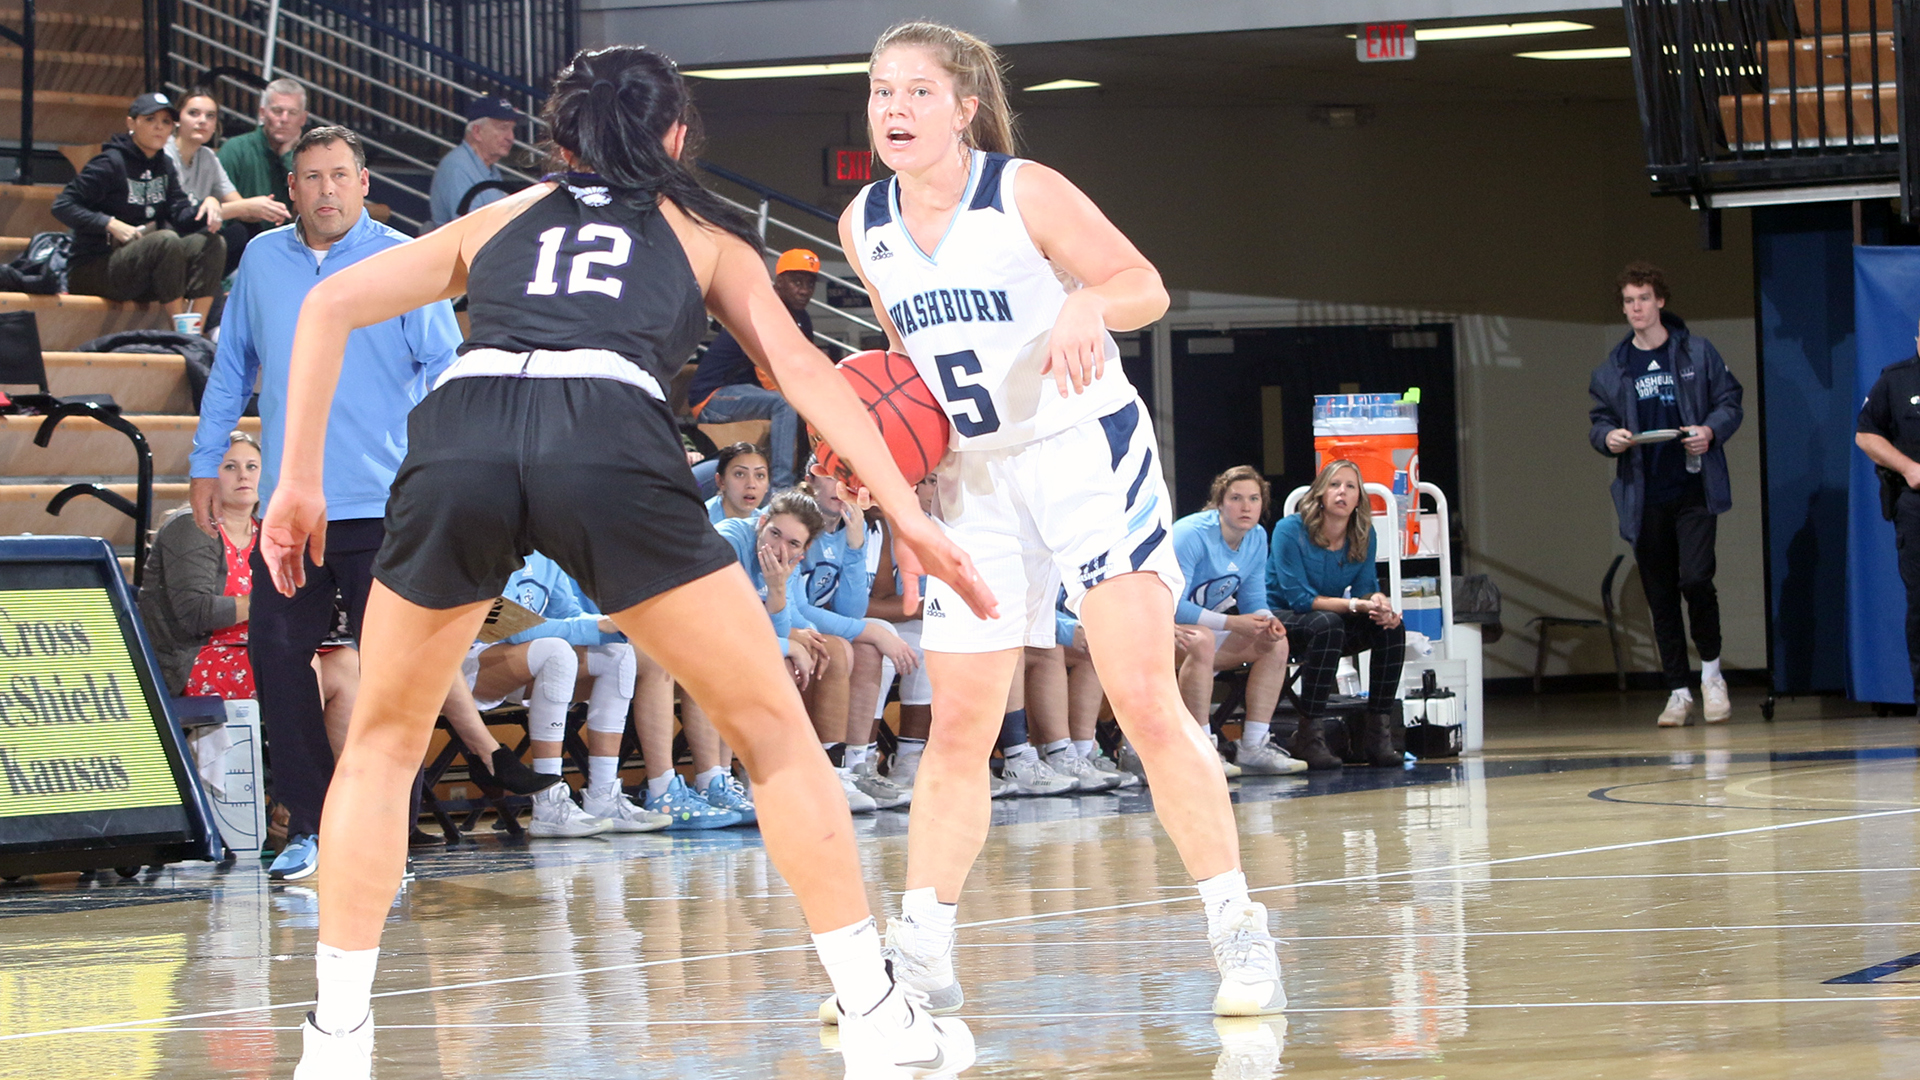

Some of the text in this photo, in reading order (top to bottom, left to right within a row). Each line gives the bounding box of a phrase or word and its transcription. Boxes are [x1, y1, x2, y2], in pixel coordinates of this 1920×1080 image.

[1365, 23, 1408, 58] EXIT
[837, 150, 871, 180] EXIT
[525, 222, 634, 300] 12
[871, 252, 894, 261] adidas
[888, 287, 1014, 338] WASHBURN
[934, 349, 1001, 438] 5
[0, 745, 131, 795] Kansas
